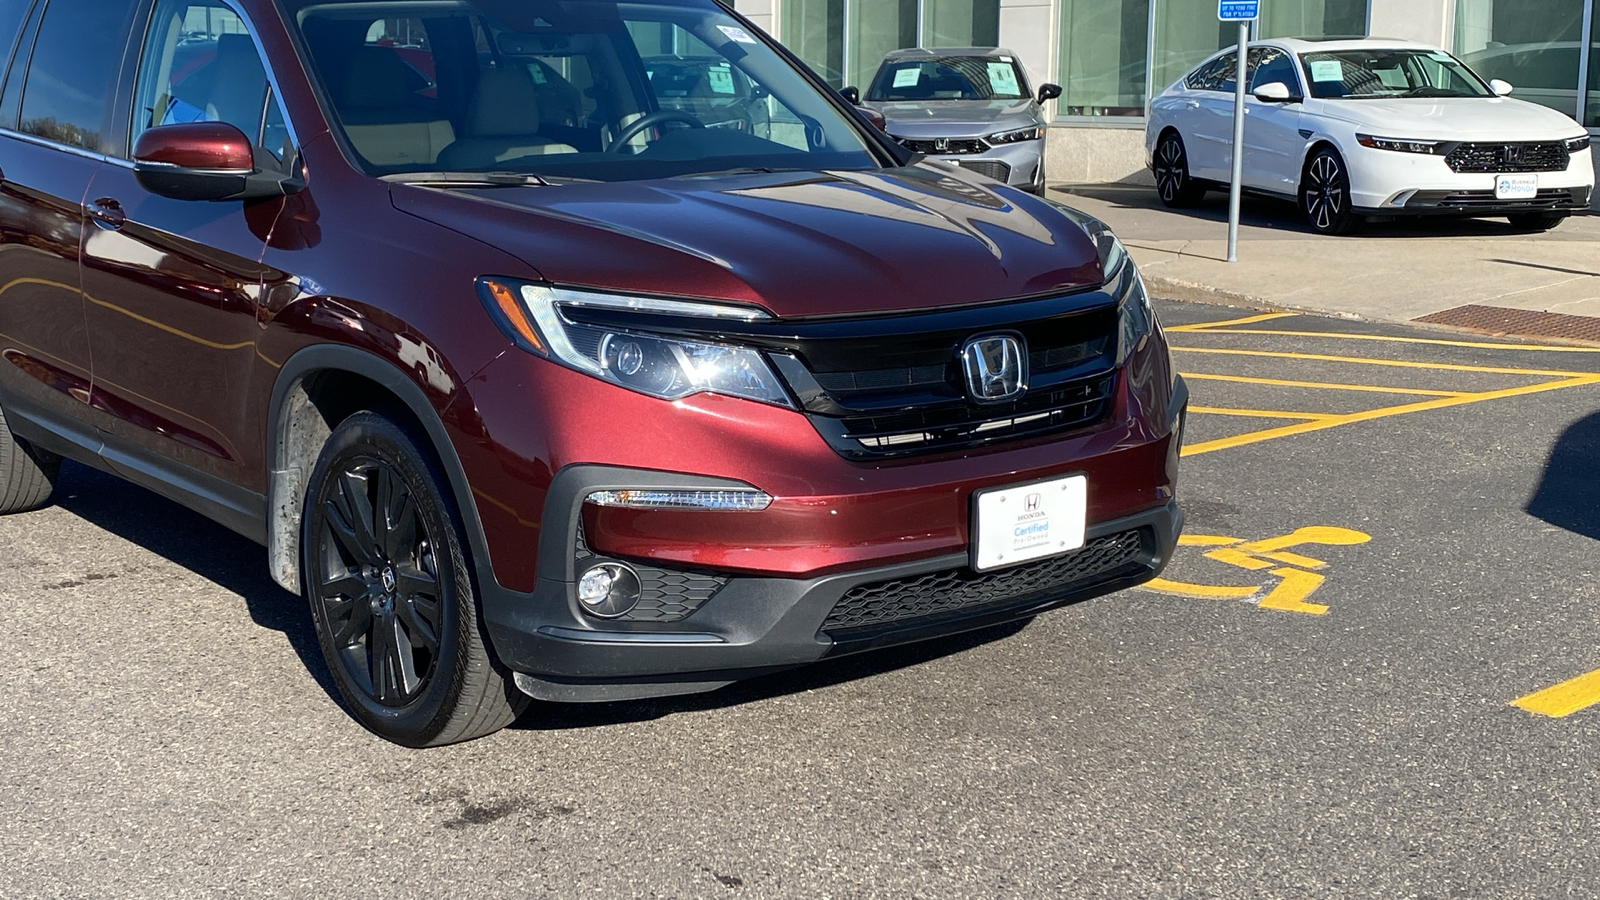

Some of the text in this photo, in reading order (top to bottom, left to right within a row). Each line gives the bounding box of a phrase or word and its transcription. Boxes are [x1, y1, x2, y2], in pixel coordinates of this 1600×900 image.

[1017, 511, 1046, 521] HONDA
[1014, 521, 1049, 537] Certified
[1013, 532, 1049, 545] Pre-Owned
